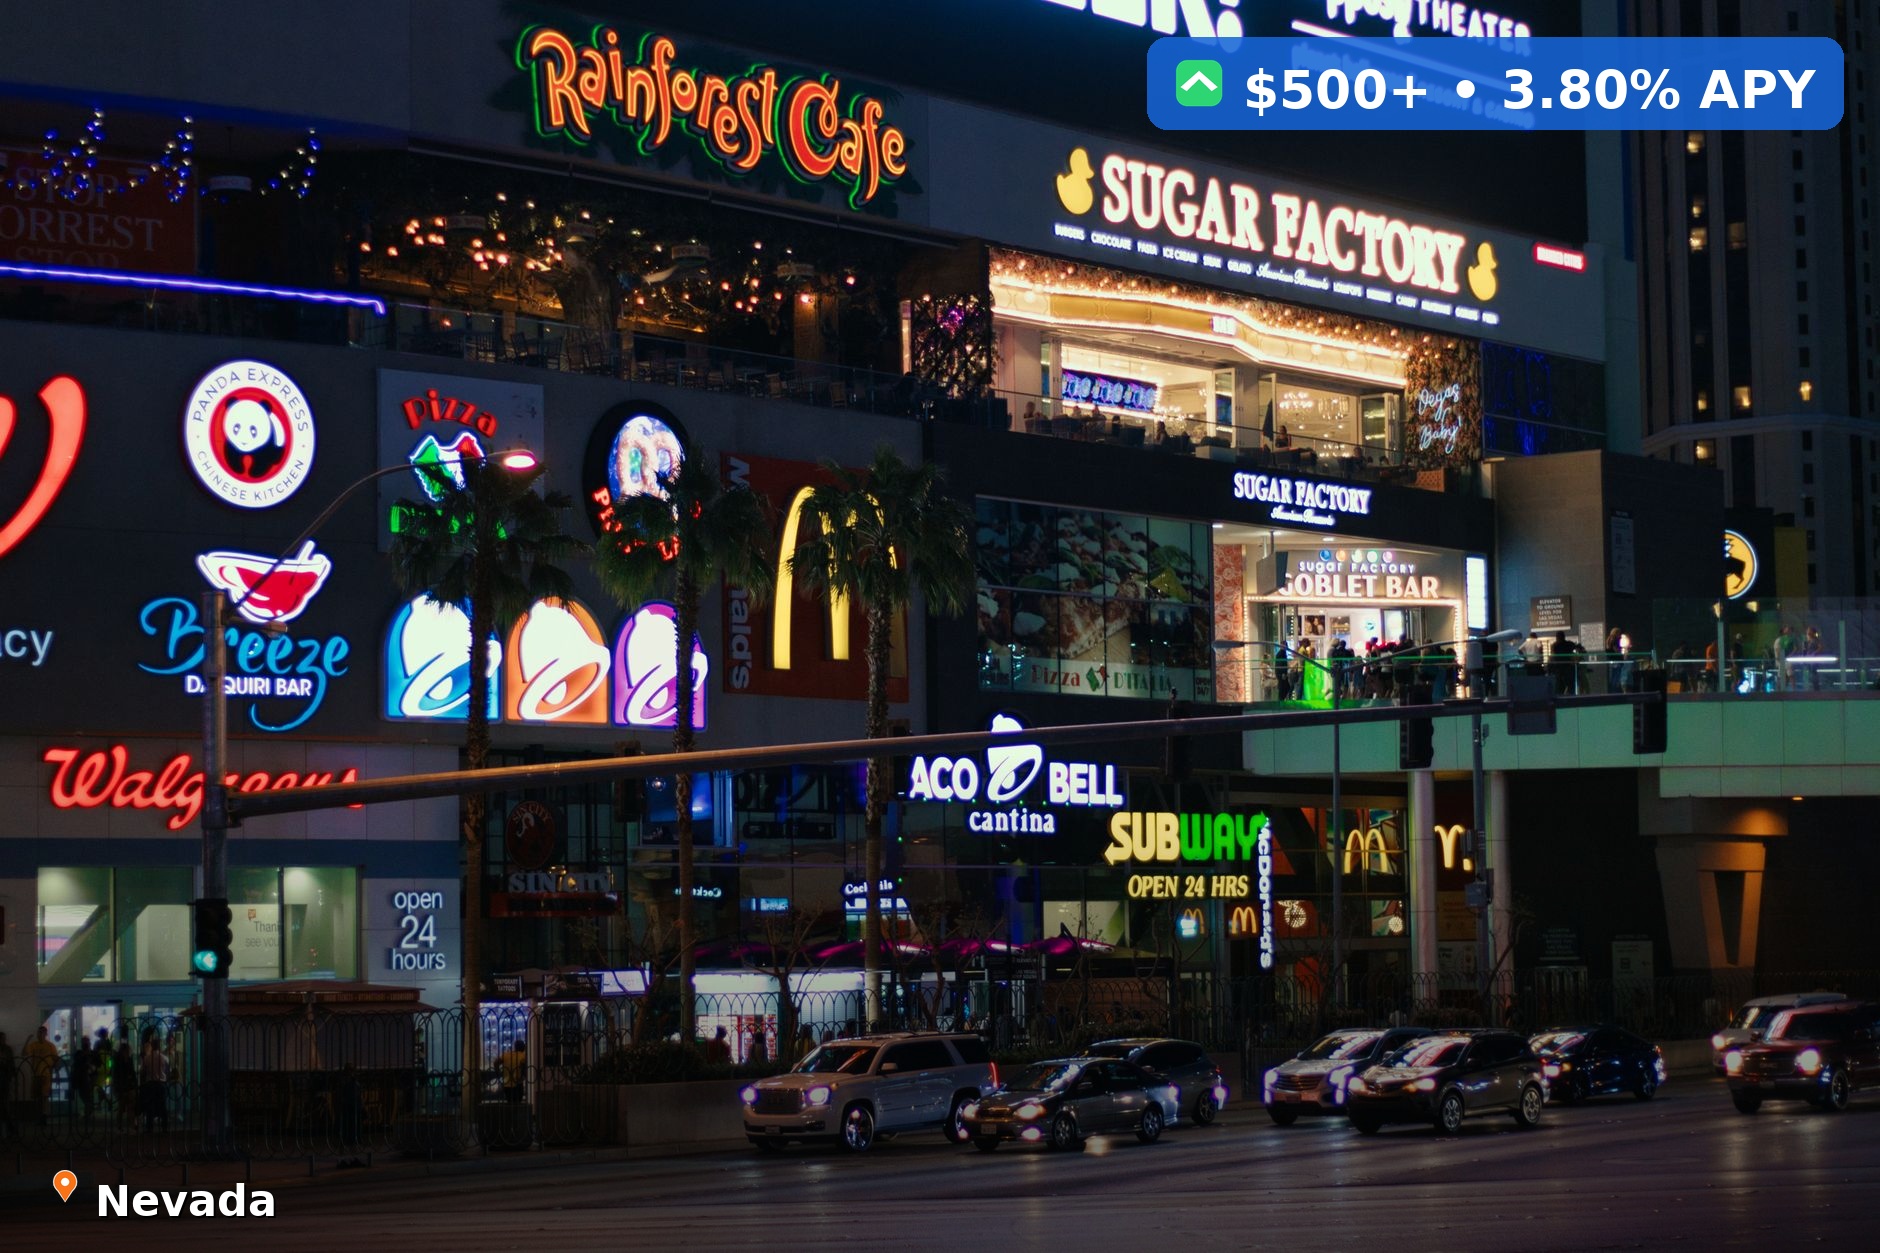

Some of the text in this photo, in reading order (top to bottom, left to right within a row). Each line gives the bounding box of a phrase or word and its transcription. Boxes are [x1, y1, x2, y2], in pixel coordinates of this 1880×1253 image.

[520, 25, 907, 204] Rainforest Cafe
[1102, 155, 1465, 293] SUGAR FACTORY
[193, 368, 309, 432] PANDA EXPRESS
[197, 450, 304, 501] CHINESE KITCHEN
[1234, 472, 1371, 515] SUGAR FACTORY
[1350, 563, 1416, 574] FACTORY
[1386, 575, 1439, 599] BAR
[0, 629, 53, 666] cy
[138, 597, 349, 732] Breeze
[186, 675, 312, 697] DQUIRI BAR
[1031, 664, 1081, 687] Pizza
[909, 756, 1124, 806] ACO BELL
[969, 807, 1056, 833] cantina
[1104, 811, 1268, 866] SUBWAY
[394, 891, 443, 914] open
[1128, 874, 1249, 898] OPEN 24 HRS
[401, 914, 437, 949] 24
[392, 948, 446, 970] hours
